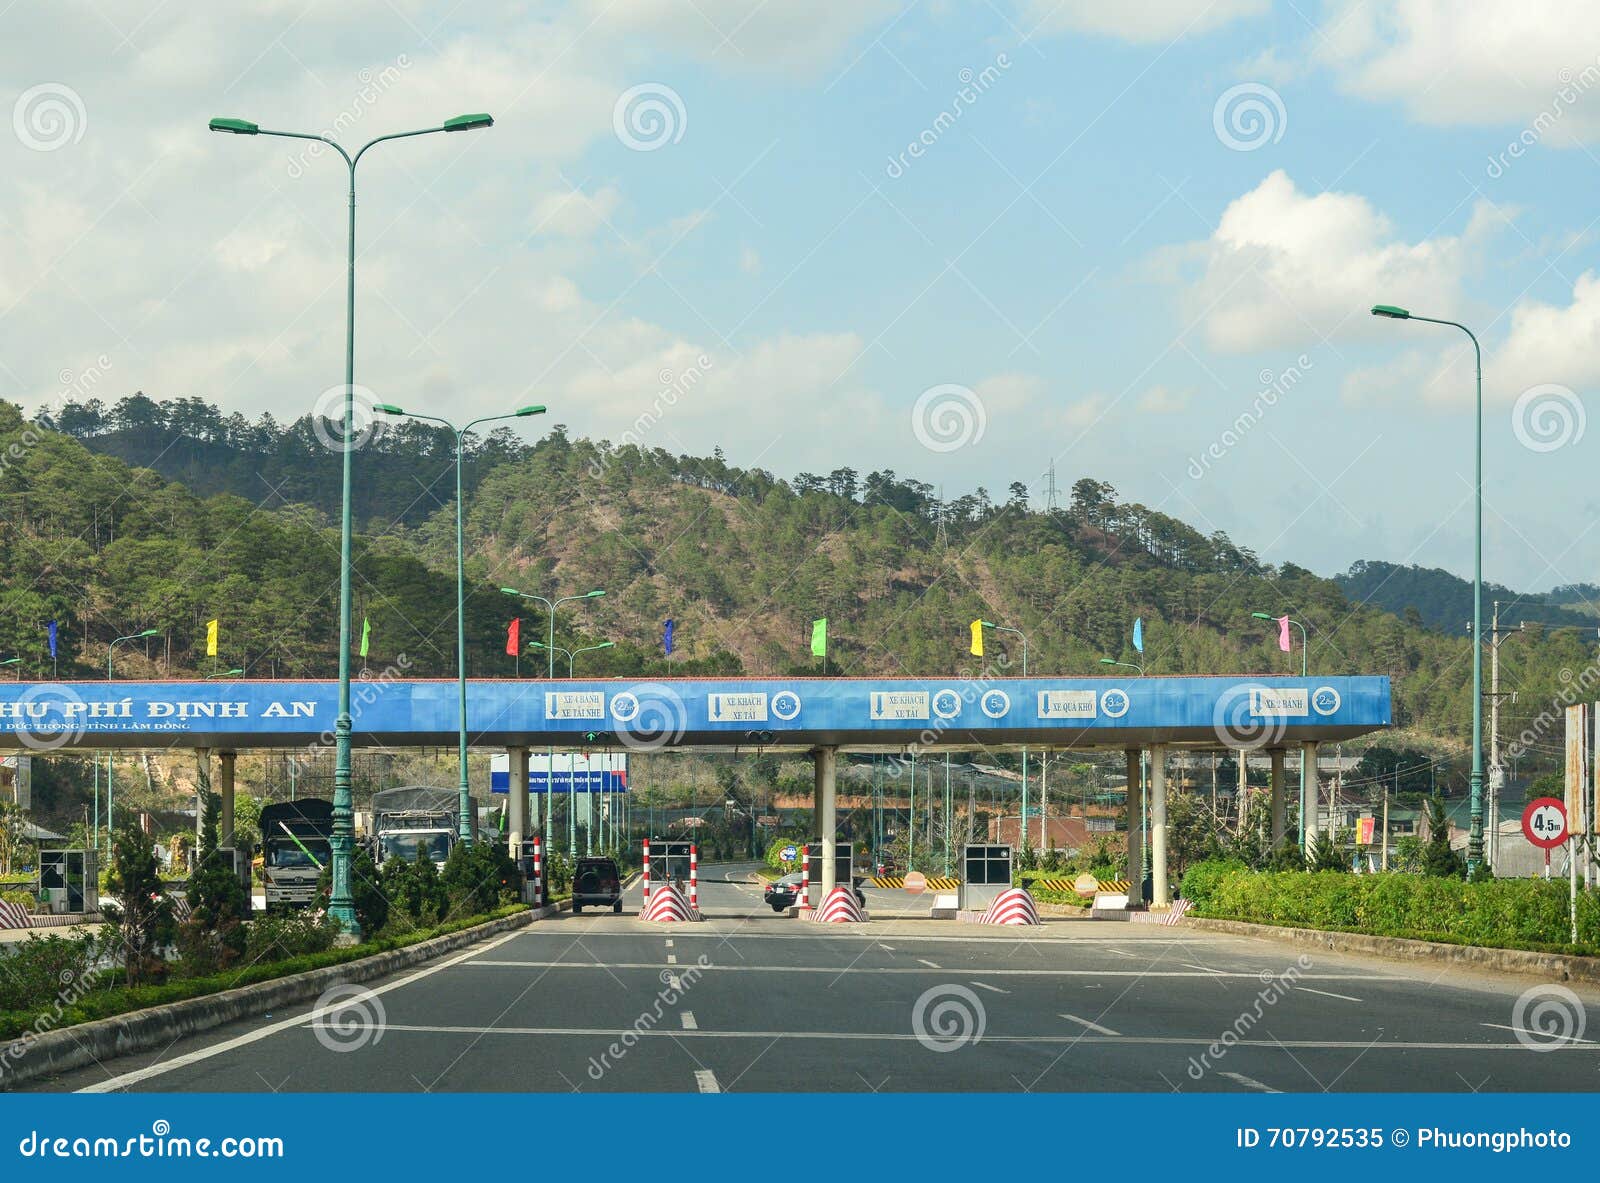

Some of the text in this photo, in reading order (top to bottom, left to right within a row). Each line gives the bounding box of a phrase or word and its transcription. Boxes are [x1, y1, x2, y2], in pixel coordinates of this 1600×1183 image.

[63, 697, 134, 718] PHÍ
[146, 702, 249, 721] ĐỊNH
[260, 702, 318, 718] AN
